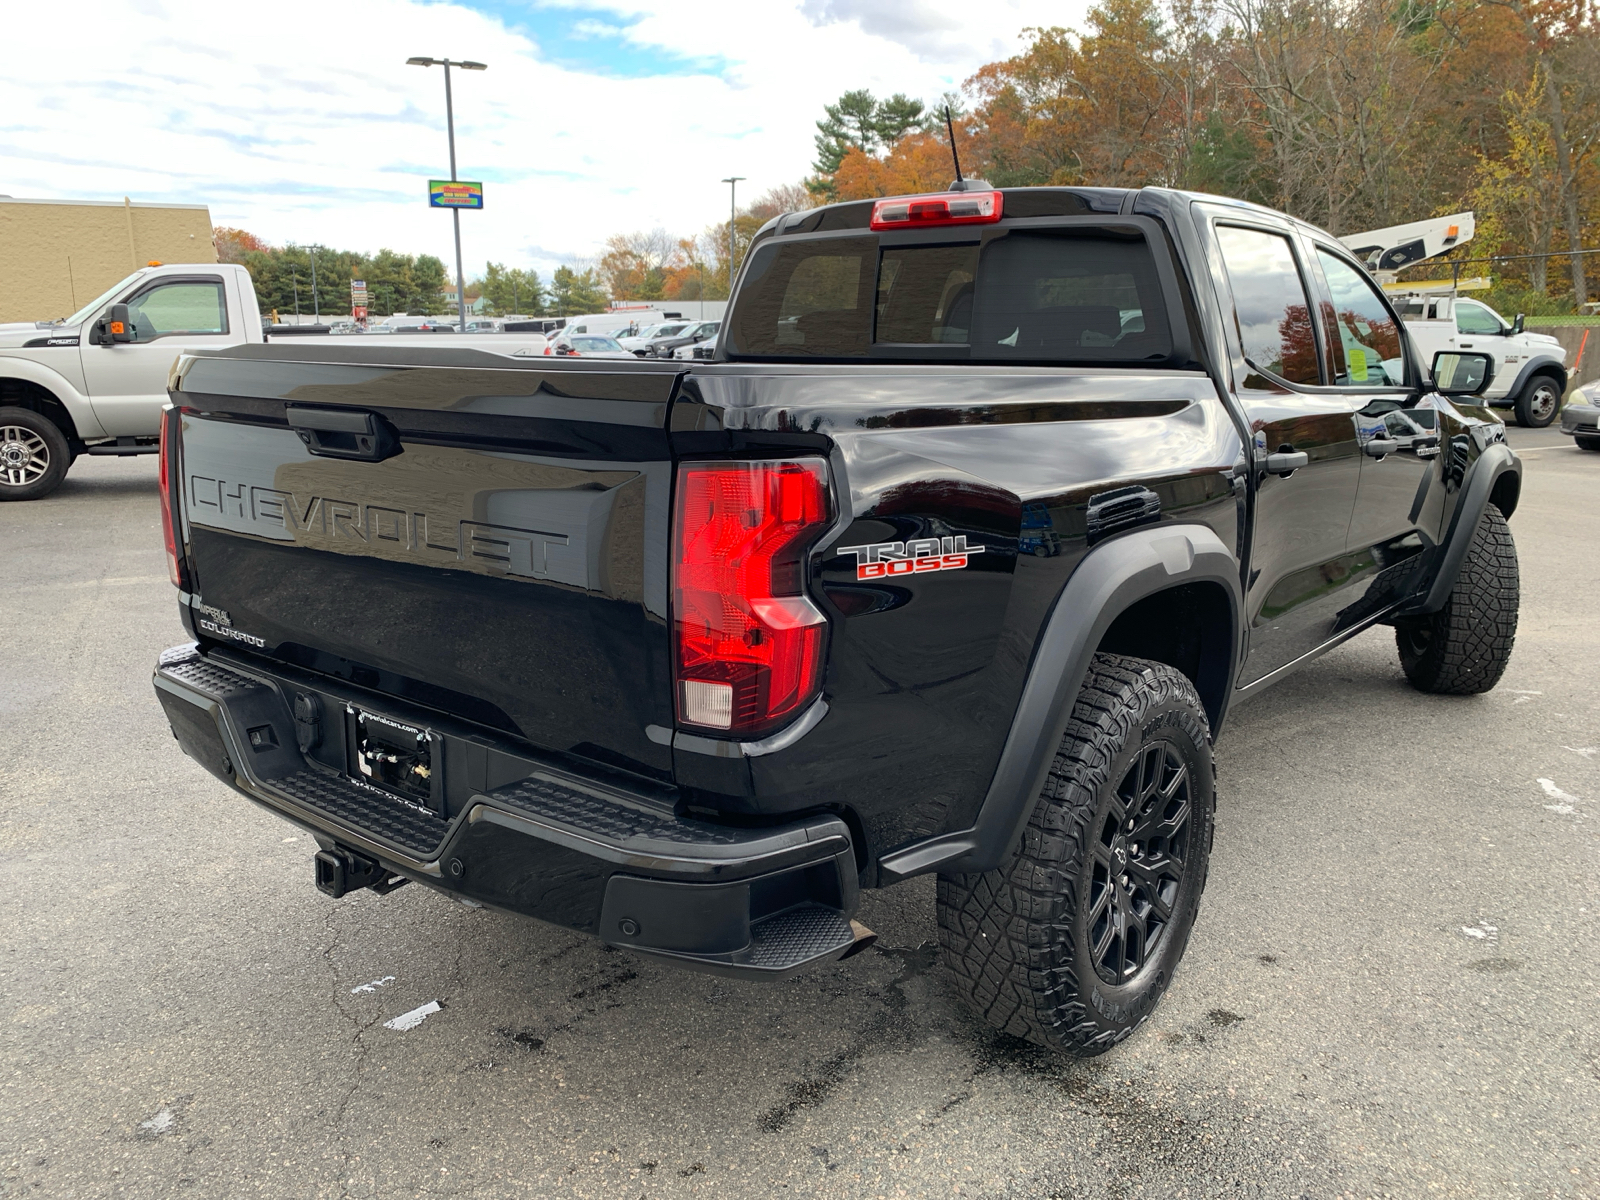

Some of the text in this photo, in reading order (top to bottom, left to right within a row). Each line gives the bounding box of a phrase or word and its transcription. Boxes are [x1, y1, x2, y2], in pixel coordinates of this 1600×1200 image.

[191, 475, 570, 575] CHEVROLET
[837, 535, 985, 564] TRAIL
[857, 554, 968, 580] BOSS
[200, 619, 266, 648] COLORADO
